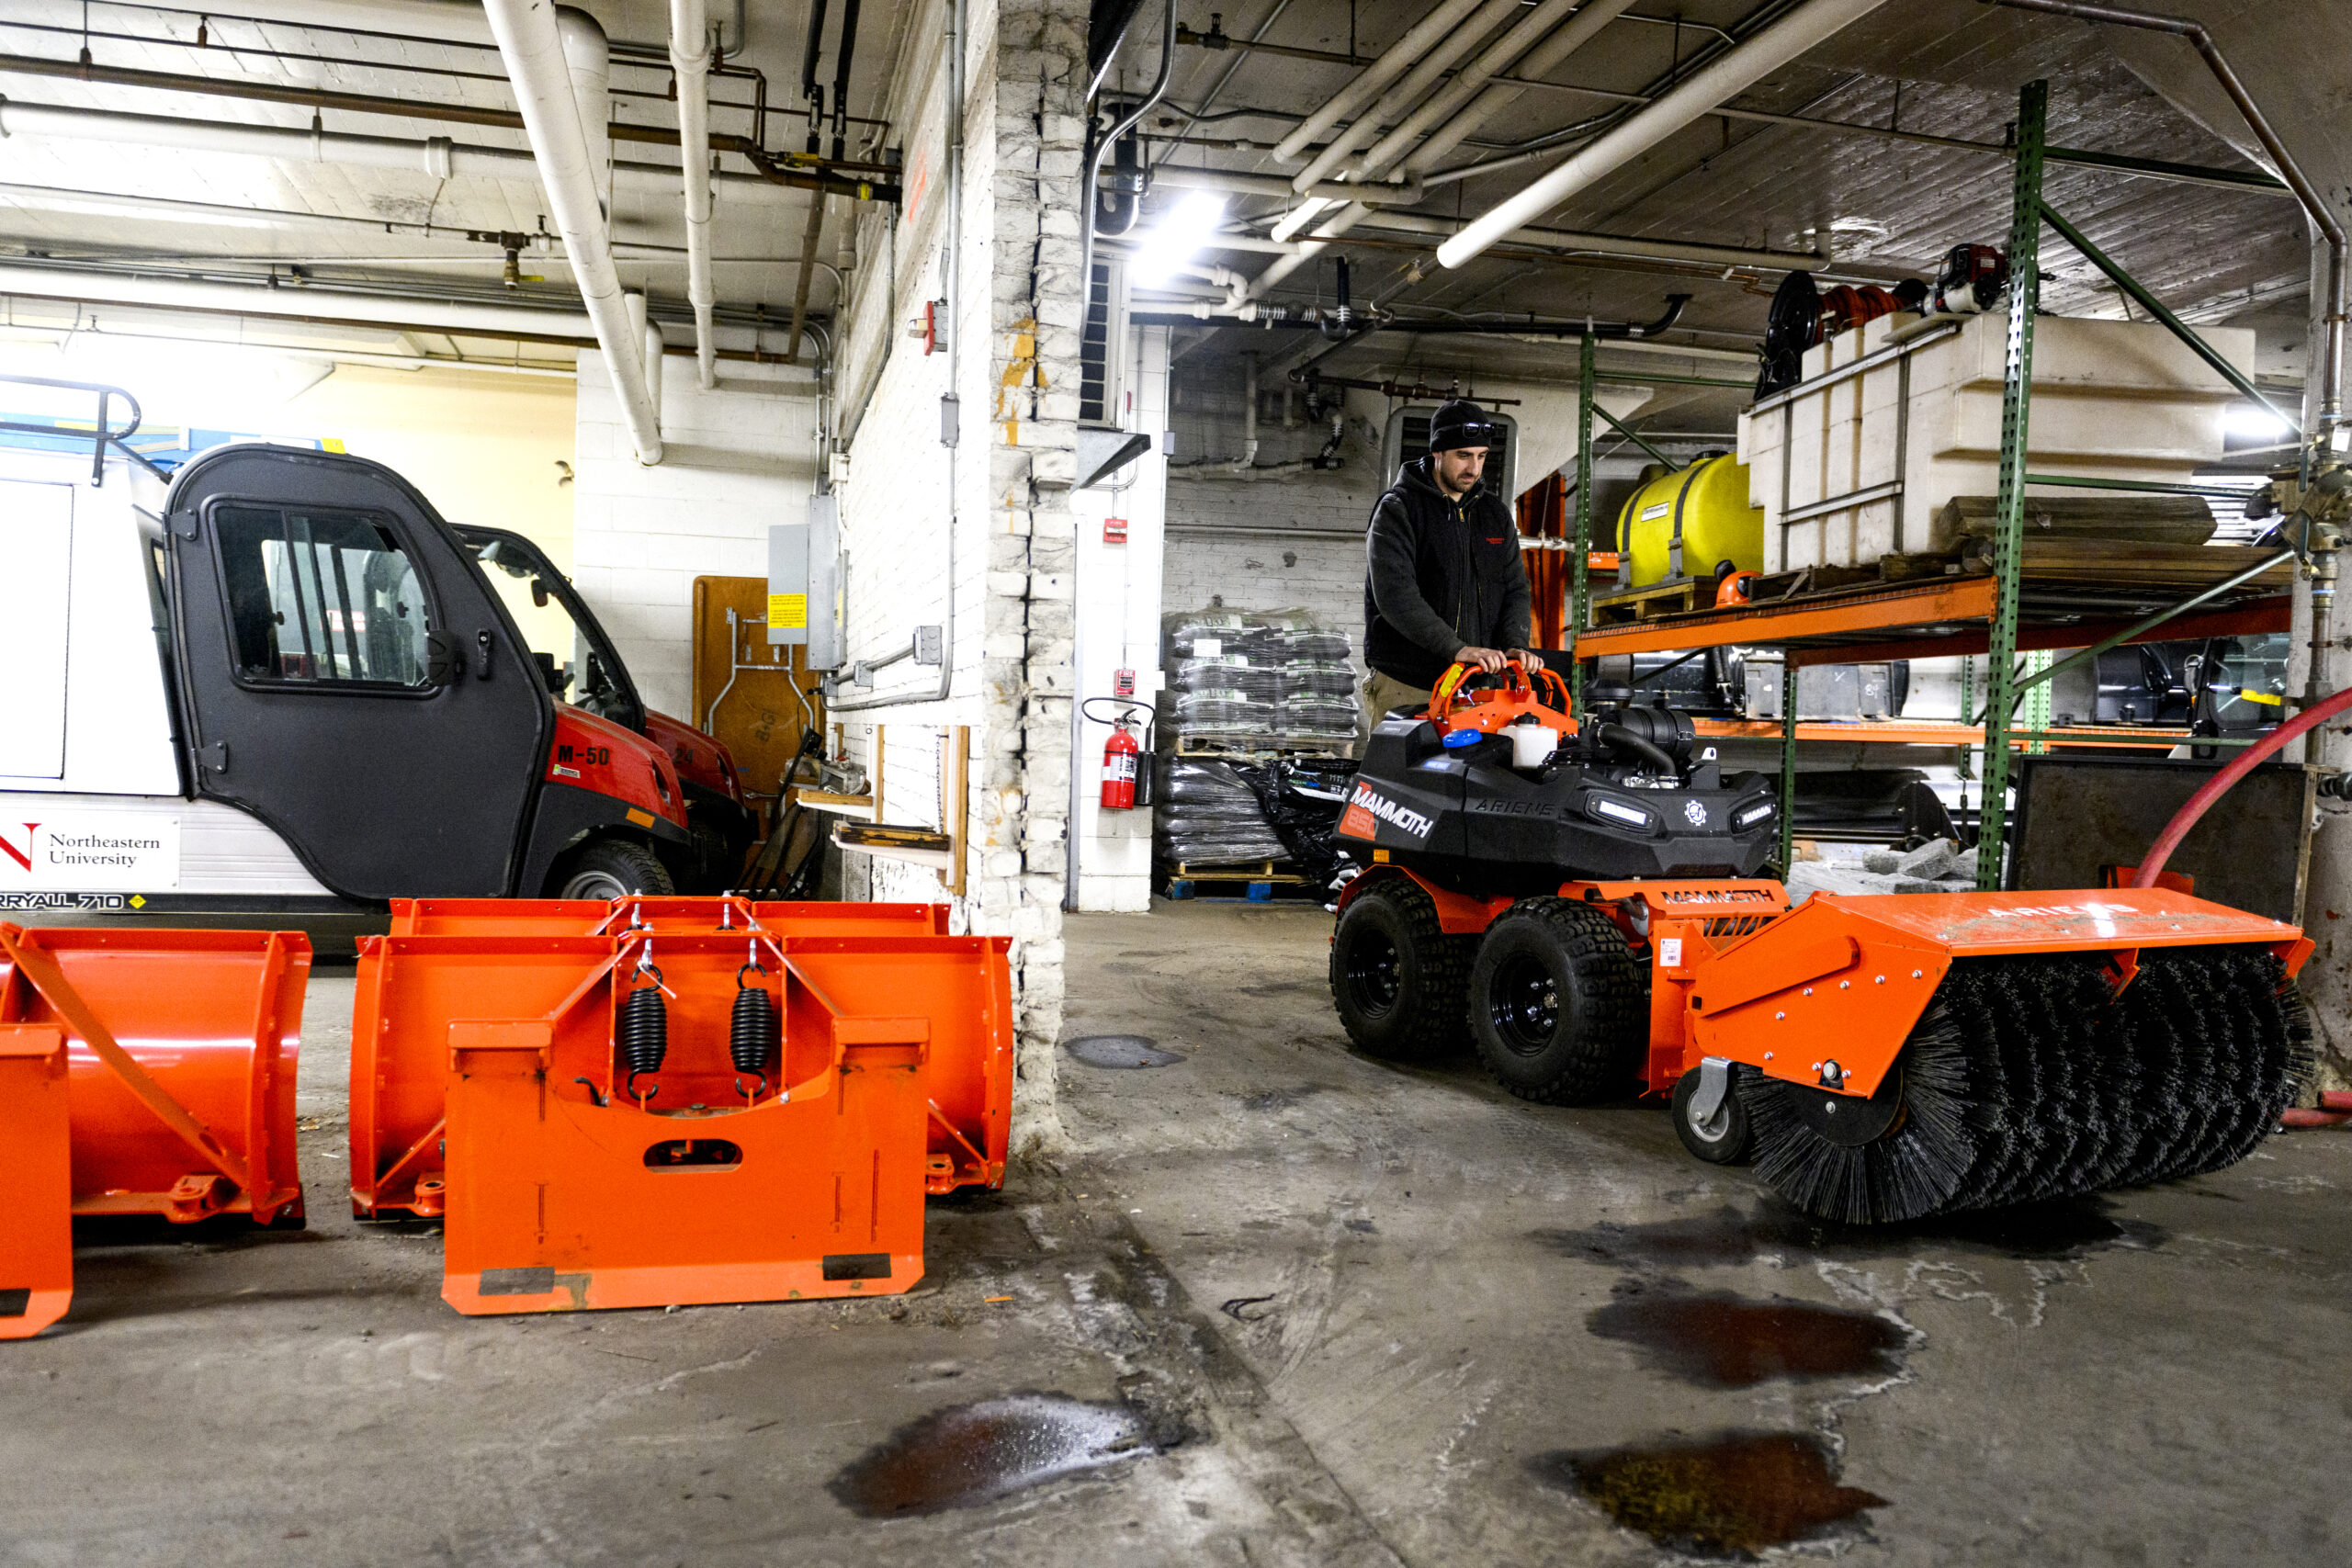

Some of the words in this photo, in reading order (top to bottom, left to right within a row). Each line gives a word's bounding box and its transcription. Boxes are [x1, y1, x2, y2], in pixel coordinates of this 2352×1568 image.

[558, 745, 609, 765] M-50
[1350, 785, 1433, 838] MAMMOTH
[1475, 799, 1555, 816] ARIENS
[50, 833, 160, 849] Northeastern
[50, 851, 137, 867] University
[78, 894, 124, 910] 710
[1661, 889, 1775, 904] MAMMOTH
